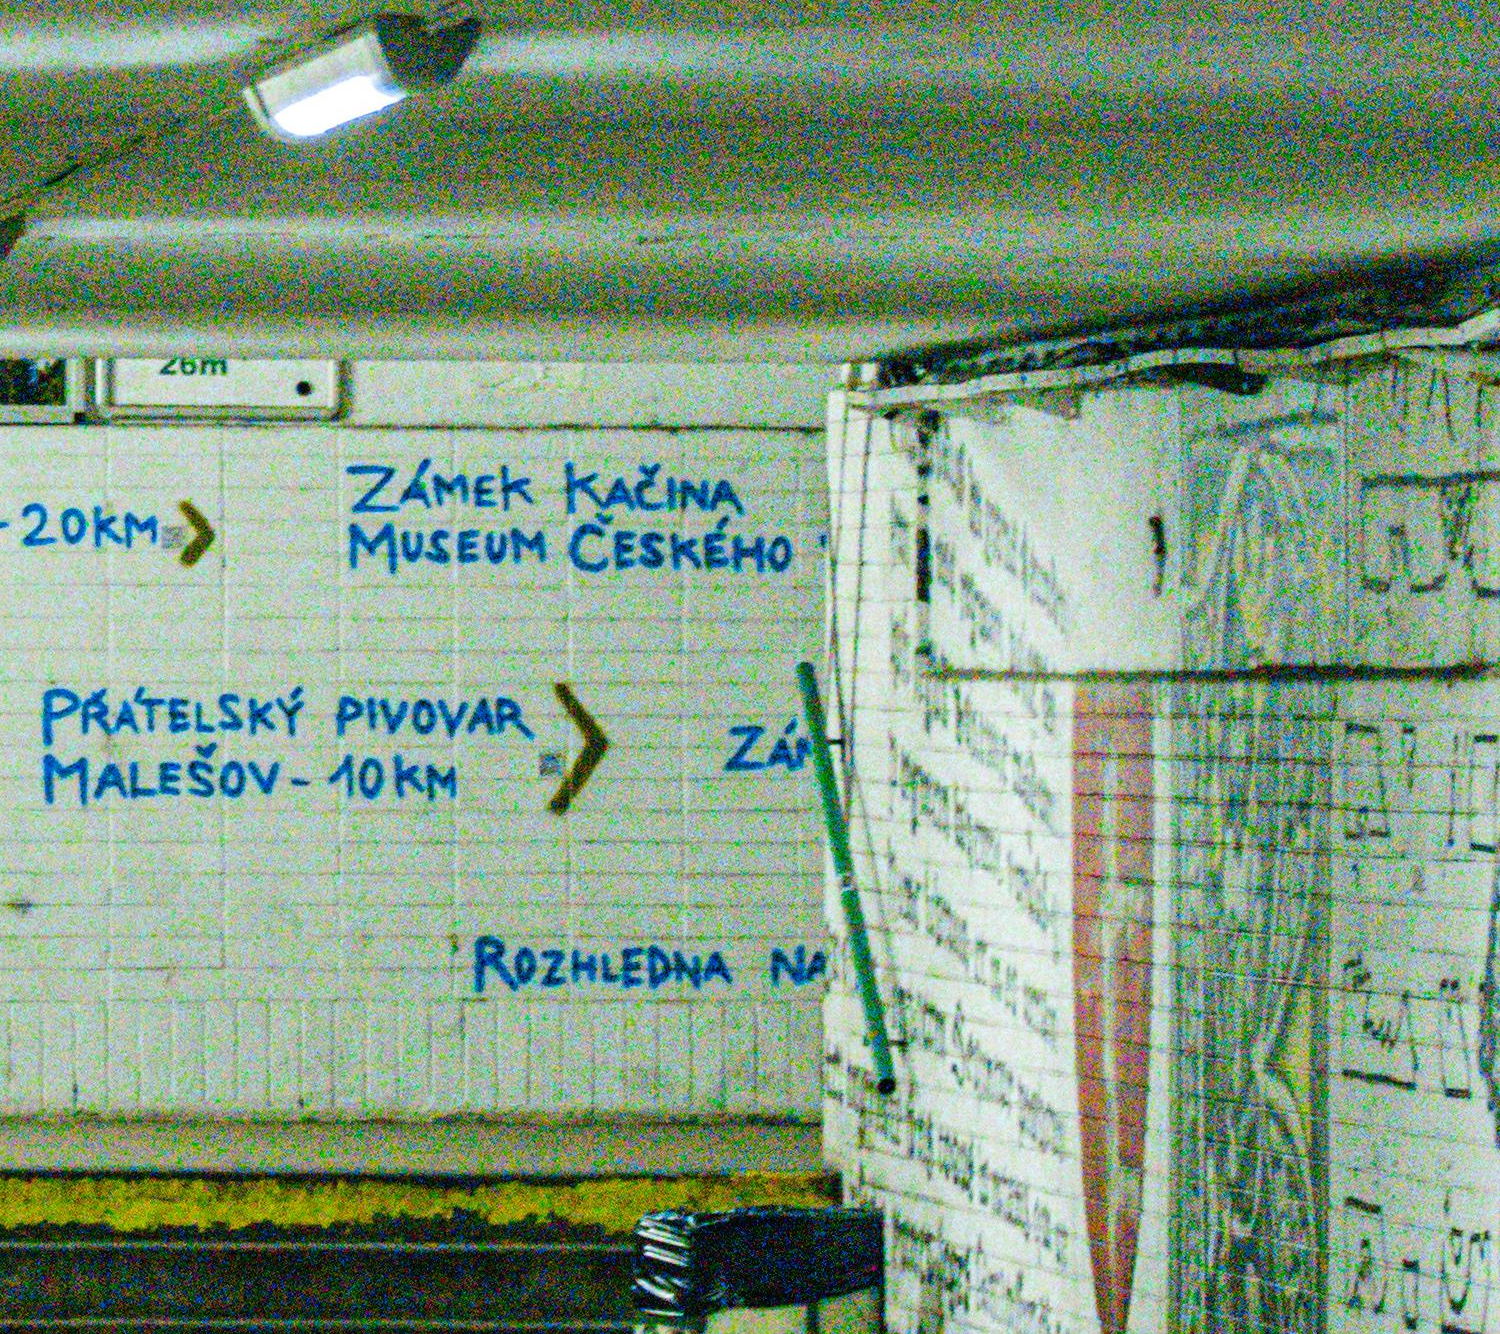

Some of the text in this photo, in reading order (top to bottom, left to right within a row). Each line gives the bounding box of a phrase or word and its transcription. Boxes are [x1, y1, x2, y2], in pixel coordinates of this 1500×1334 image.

[346, 459, 745, 514] ZÁMEK KAČINA
[349, 514, 793, 575] MUSEUM ČESKÉHO
[336, 695, 535, 741] PIVOVAR
[473, 935, 732, 992] ROZHLEDNA
